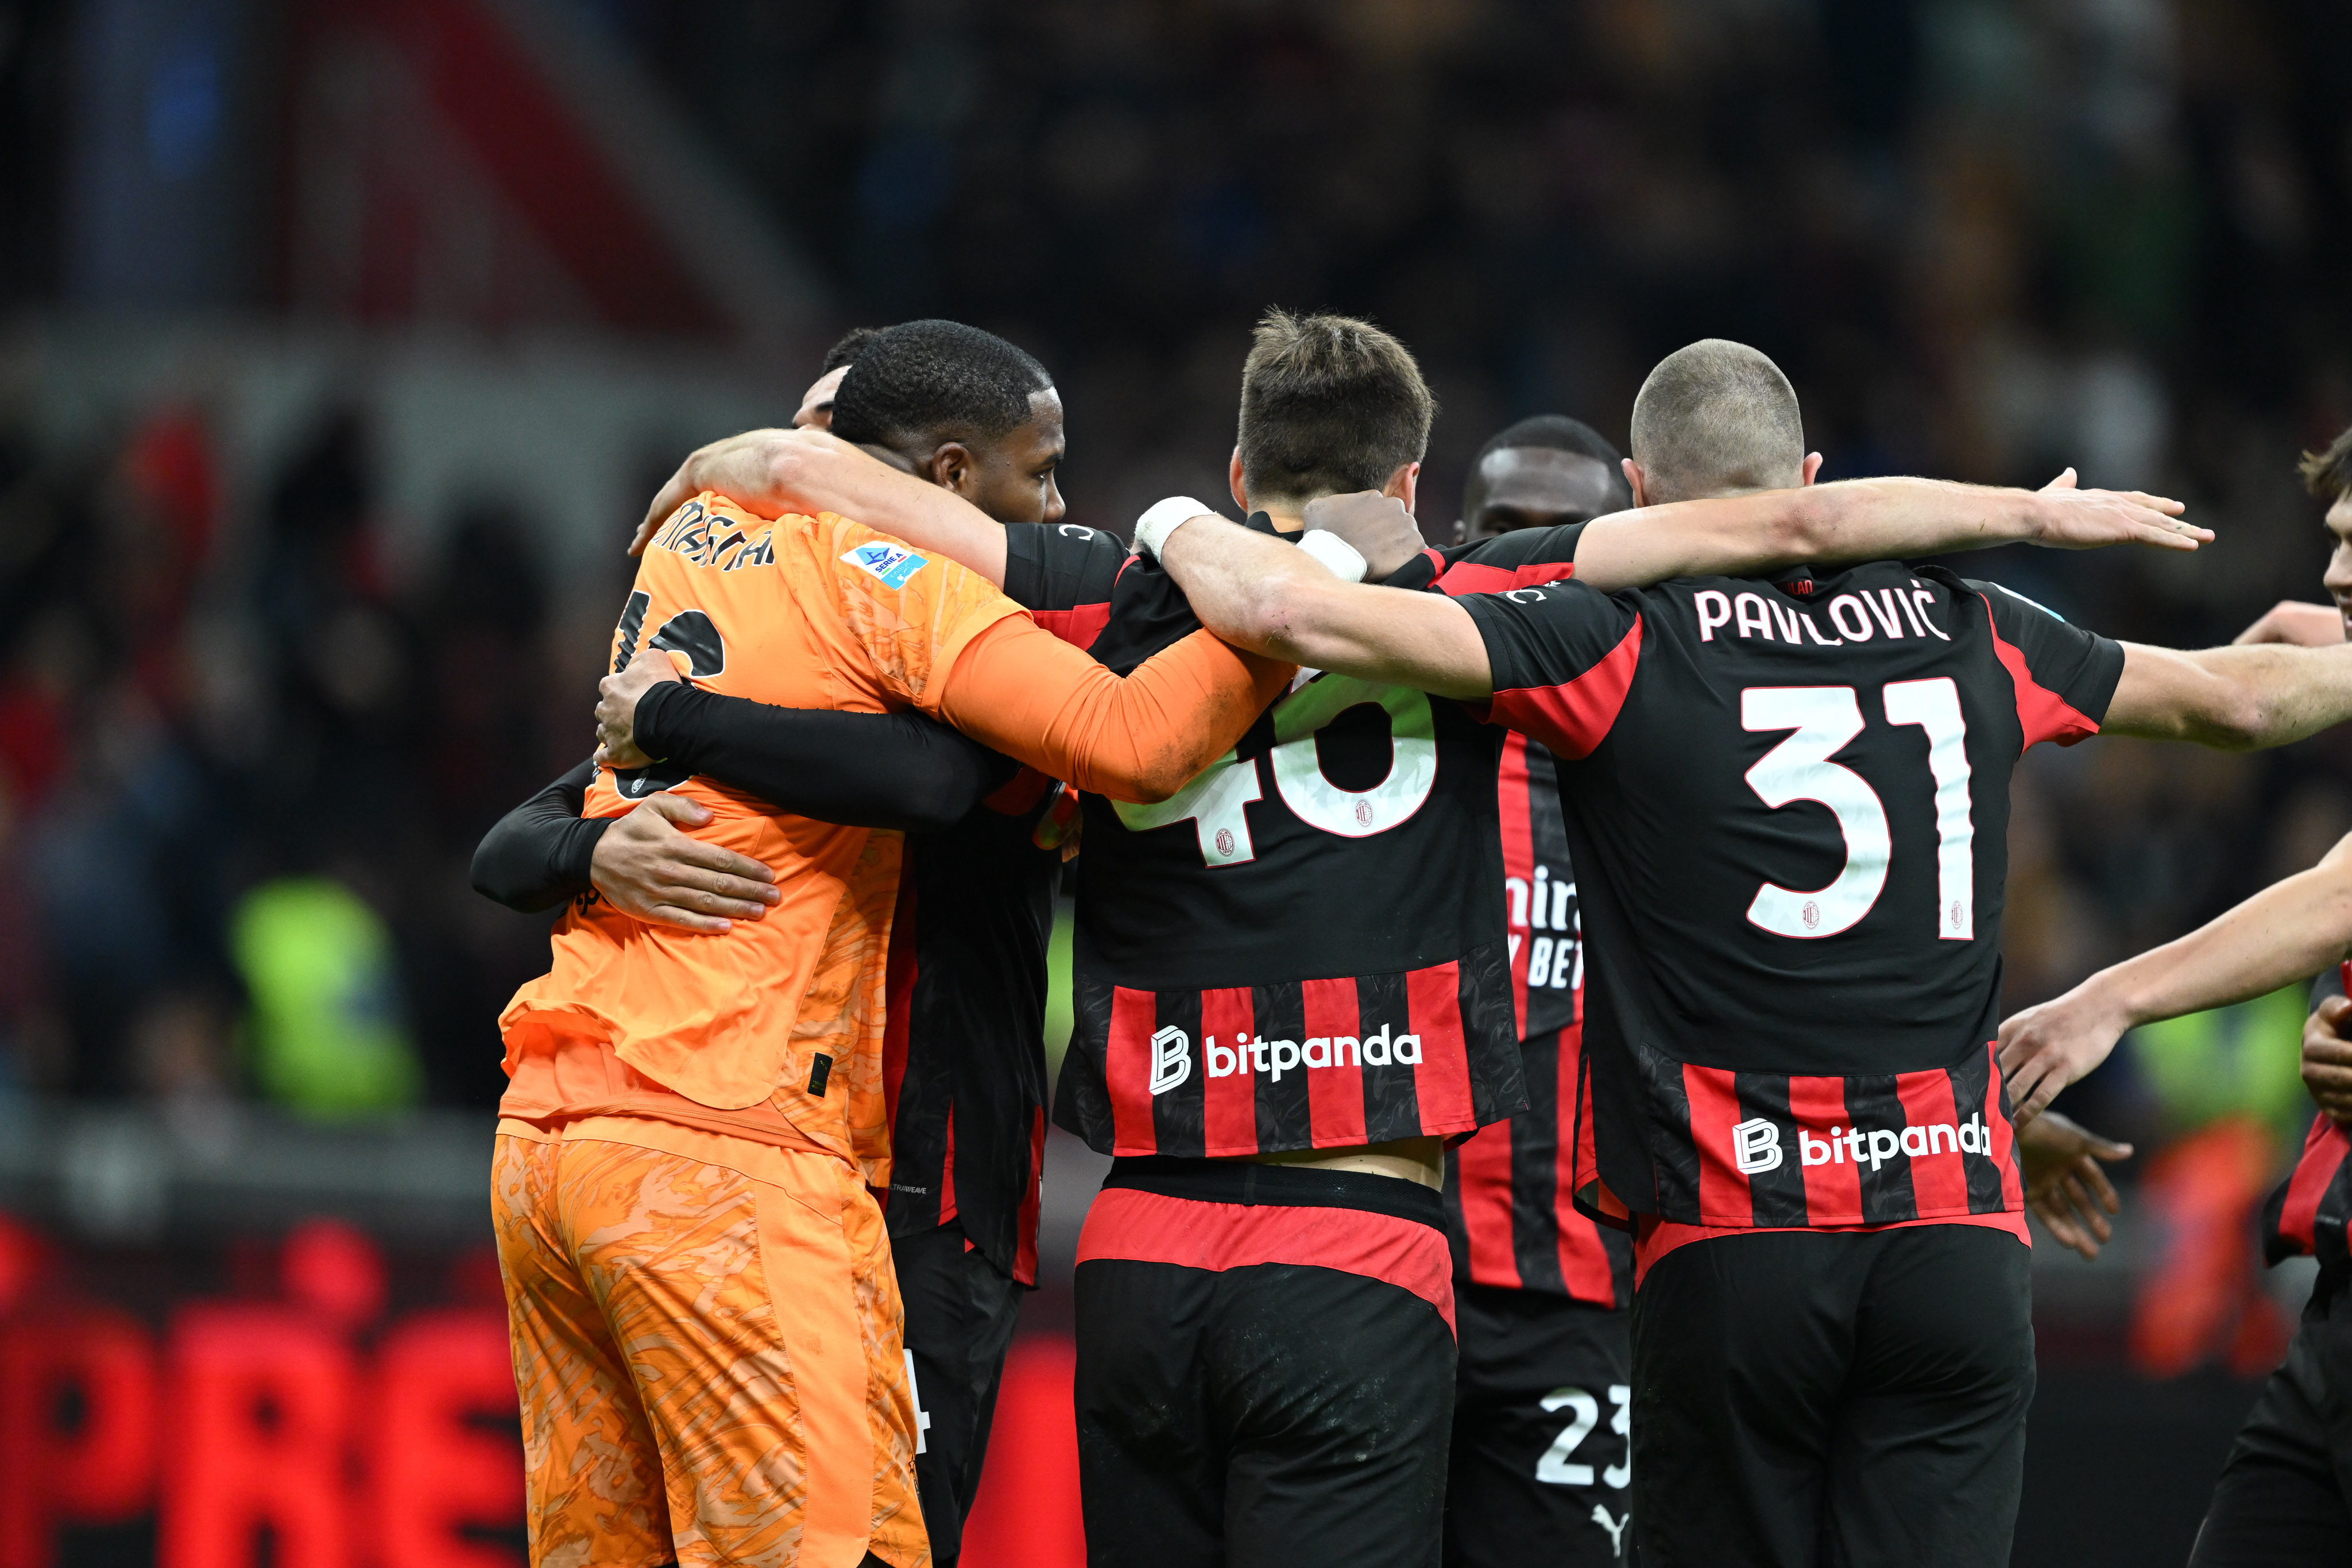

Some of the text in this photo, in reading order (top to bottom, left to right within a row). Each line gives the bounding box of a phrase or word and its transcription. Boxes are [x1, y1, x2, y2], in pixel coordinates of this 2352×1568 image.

[875, 556, 897, 572] SERIE
[1693, 579, 1951, 646] PAVLOVIĆ
[1740, 676, 1974, 940] 31
[1205, 1023, 1423, 1083] bitpanda
[1799, 1112, 1992, 1171] bitpanda
[887, 1183, 927, 1194] LTRAWEAVE
